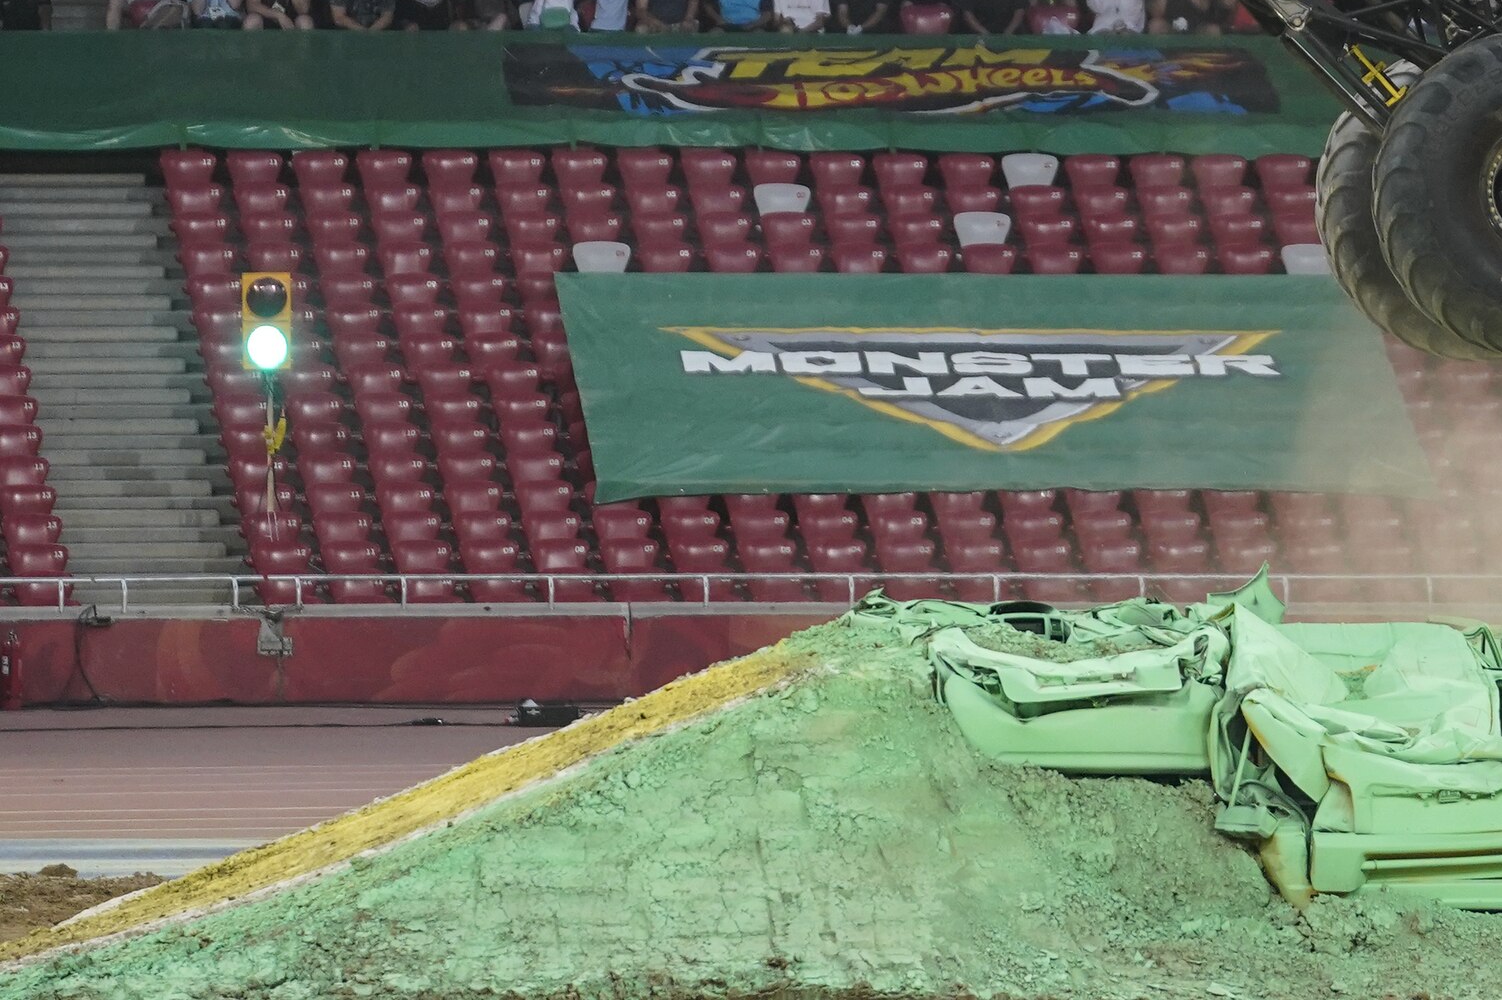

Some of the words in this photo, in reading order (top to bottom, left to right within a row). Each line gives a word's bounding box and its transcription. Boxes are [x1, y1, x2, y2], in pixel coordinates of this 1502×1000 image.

[712, 47, 1053, 78] TEAM
[680, 349, 1282, 376] MONSTER
[858, 375, 1122, 399] JAM
